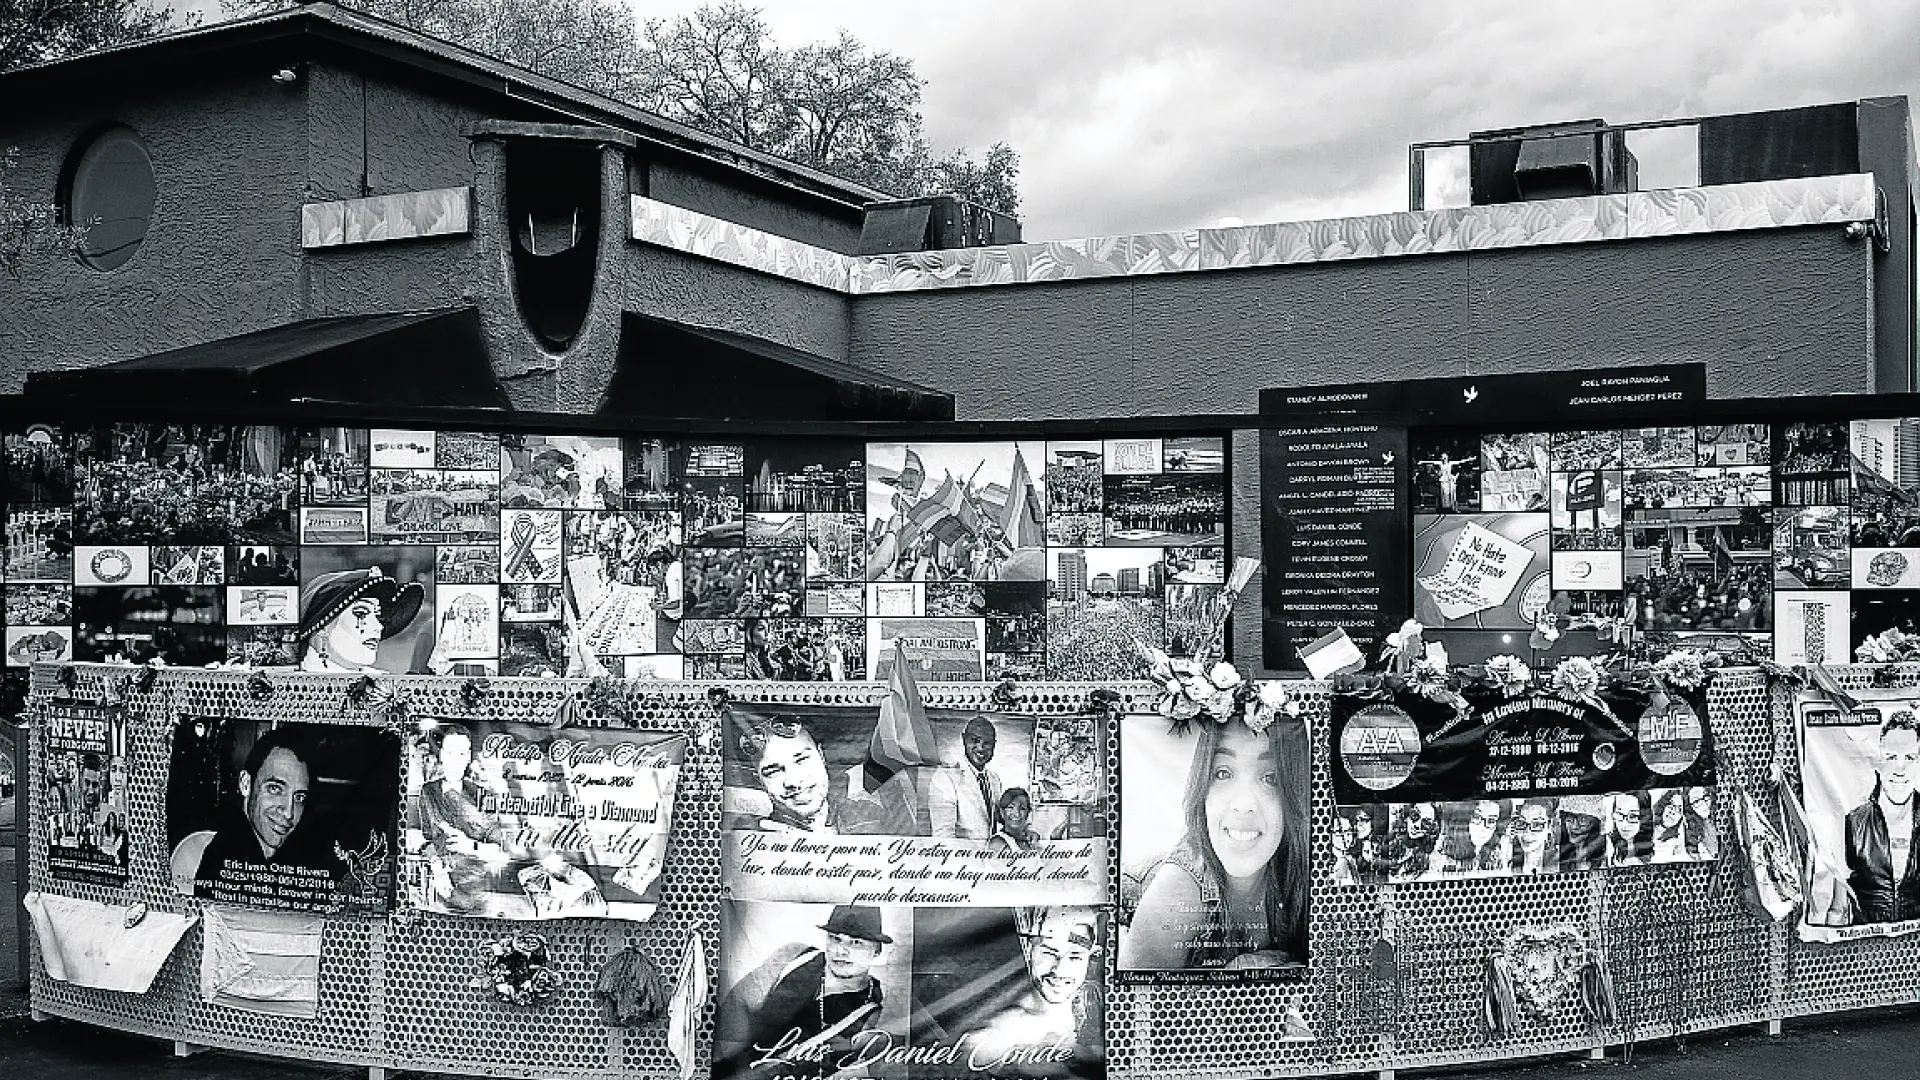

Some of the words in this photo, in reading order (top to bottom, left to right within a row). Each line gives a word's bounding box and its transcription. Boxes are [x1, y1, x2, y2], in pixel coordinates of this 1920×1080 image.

[1467, 535, 1482, 552] No
[1482, 541, 1507, 564] Hate
[1481, 711, 1495, 726] In
[1494, 700, 1530, 719] Loving
[1531, 696, 1574, 716] Memory
[1573, 707, 1587, 721] of
[50, 717, 106, 741] NEVER
[482, 734, 543, 766] Rodolfo
[588, 804, 597, 821] a
[600, 799, 659, 824] Diamond
[551, 818, 593, 851] the
[740, 832, 768, 858] Ya
[770, 842, 788, 852] no
[790, 838, 831, 855] llores
[825, 844, 858, 863] por
[887, 837, 916, 865] Yo
[917, 840, 954, 866] estoy
[954, 848, 972, 859] en
[974, 849, 994, 860] un
[996, 845, 1038, 868] lugar
[1039, 844, 1073, 860] lleno
[1075, 842, 1093, 859] de
[224, 859, 243, 870] Eric
[269, 862, 295, 875] Ortiz
[296, 866, 330, 878] Rivera
[740, 857, 767, 876] luz,
[770, 860, 815, 876] donde
[815, 862, 850, 879] existe
[849, 867, 884, 887] paz,
[888, 863, 932, 880] donde
[934, 869, 953, 880] no
[954, 864, 983, 889] hay
[984, 866, 1045, 882] maldad,
[1046, 864, 1091, 880] donde
[238, 893, 248, 903] in
[293, 901, 310, 910] our
[278, 886, 313, 899] forever
[314, 890, 327, 900] in
[328, 893, 347, 901] our
[899, 886, 971, 903] descansar.
[749, 1027, 834, 1070] Luis
[835, 1030, 972, 1071] Daniel
[967, 1031, 1076, 1072] Conde
